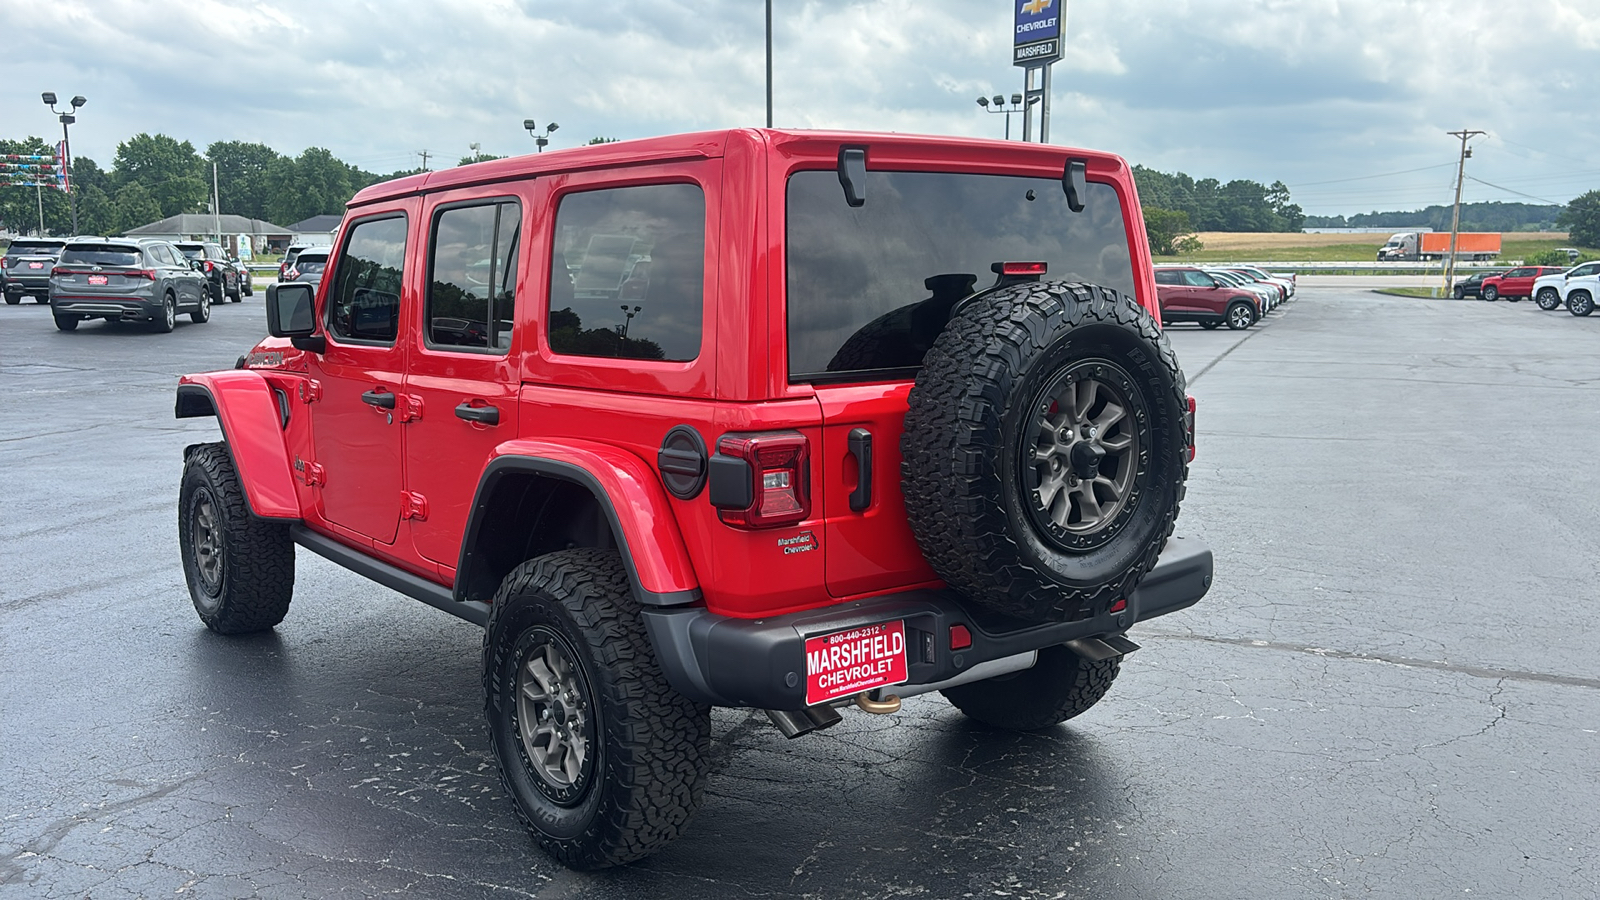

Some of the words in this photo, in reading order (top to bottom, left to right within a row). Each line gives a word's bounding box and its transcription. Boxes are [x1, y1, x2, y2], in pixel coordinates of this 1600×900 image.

[1016, 17, 1057, 34] CHEVROLET
[1017, 43, 1053, 59] MARSHFIELD
[777, 534, 810, 547] Marshfield
[784, 543, 813, 555] Chevrolet
[830, 626, 880, 645] 800-440-2312
[807, 631, 904, 676] MARSHFIELD
[818, 658, 894, 689] CHEVROLET
[829, 676, 883, 694] www.MarshfieldChevrolet.com
